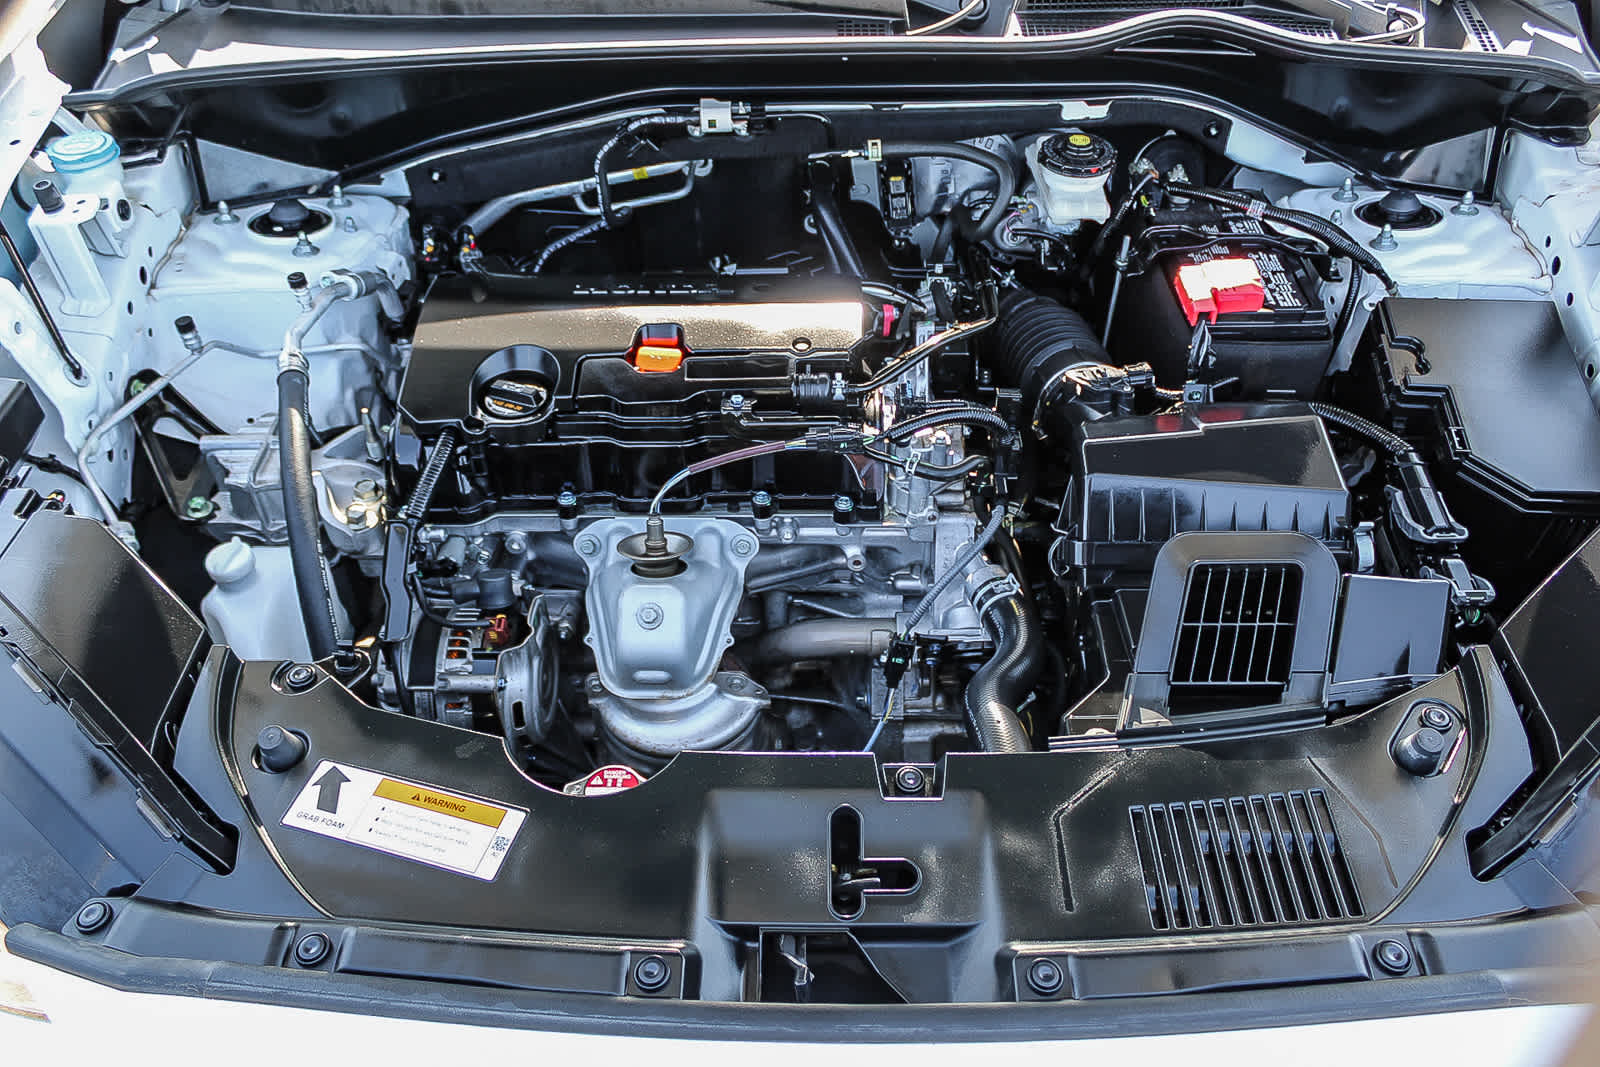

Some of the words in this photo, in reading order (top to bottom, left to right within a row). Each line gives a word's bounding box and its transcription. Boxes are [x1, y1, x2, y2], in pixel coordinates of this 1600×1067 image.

[424, 795, 467, 813] WARNING
[296, 811, 320, 823] GRAB
[321, 818, 345, 829] FOAM
